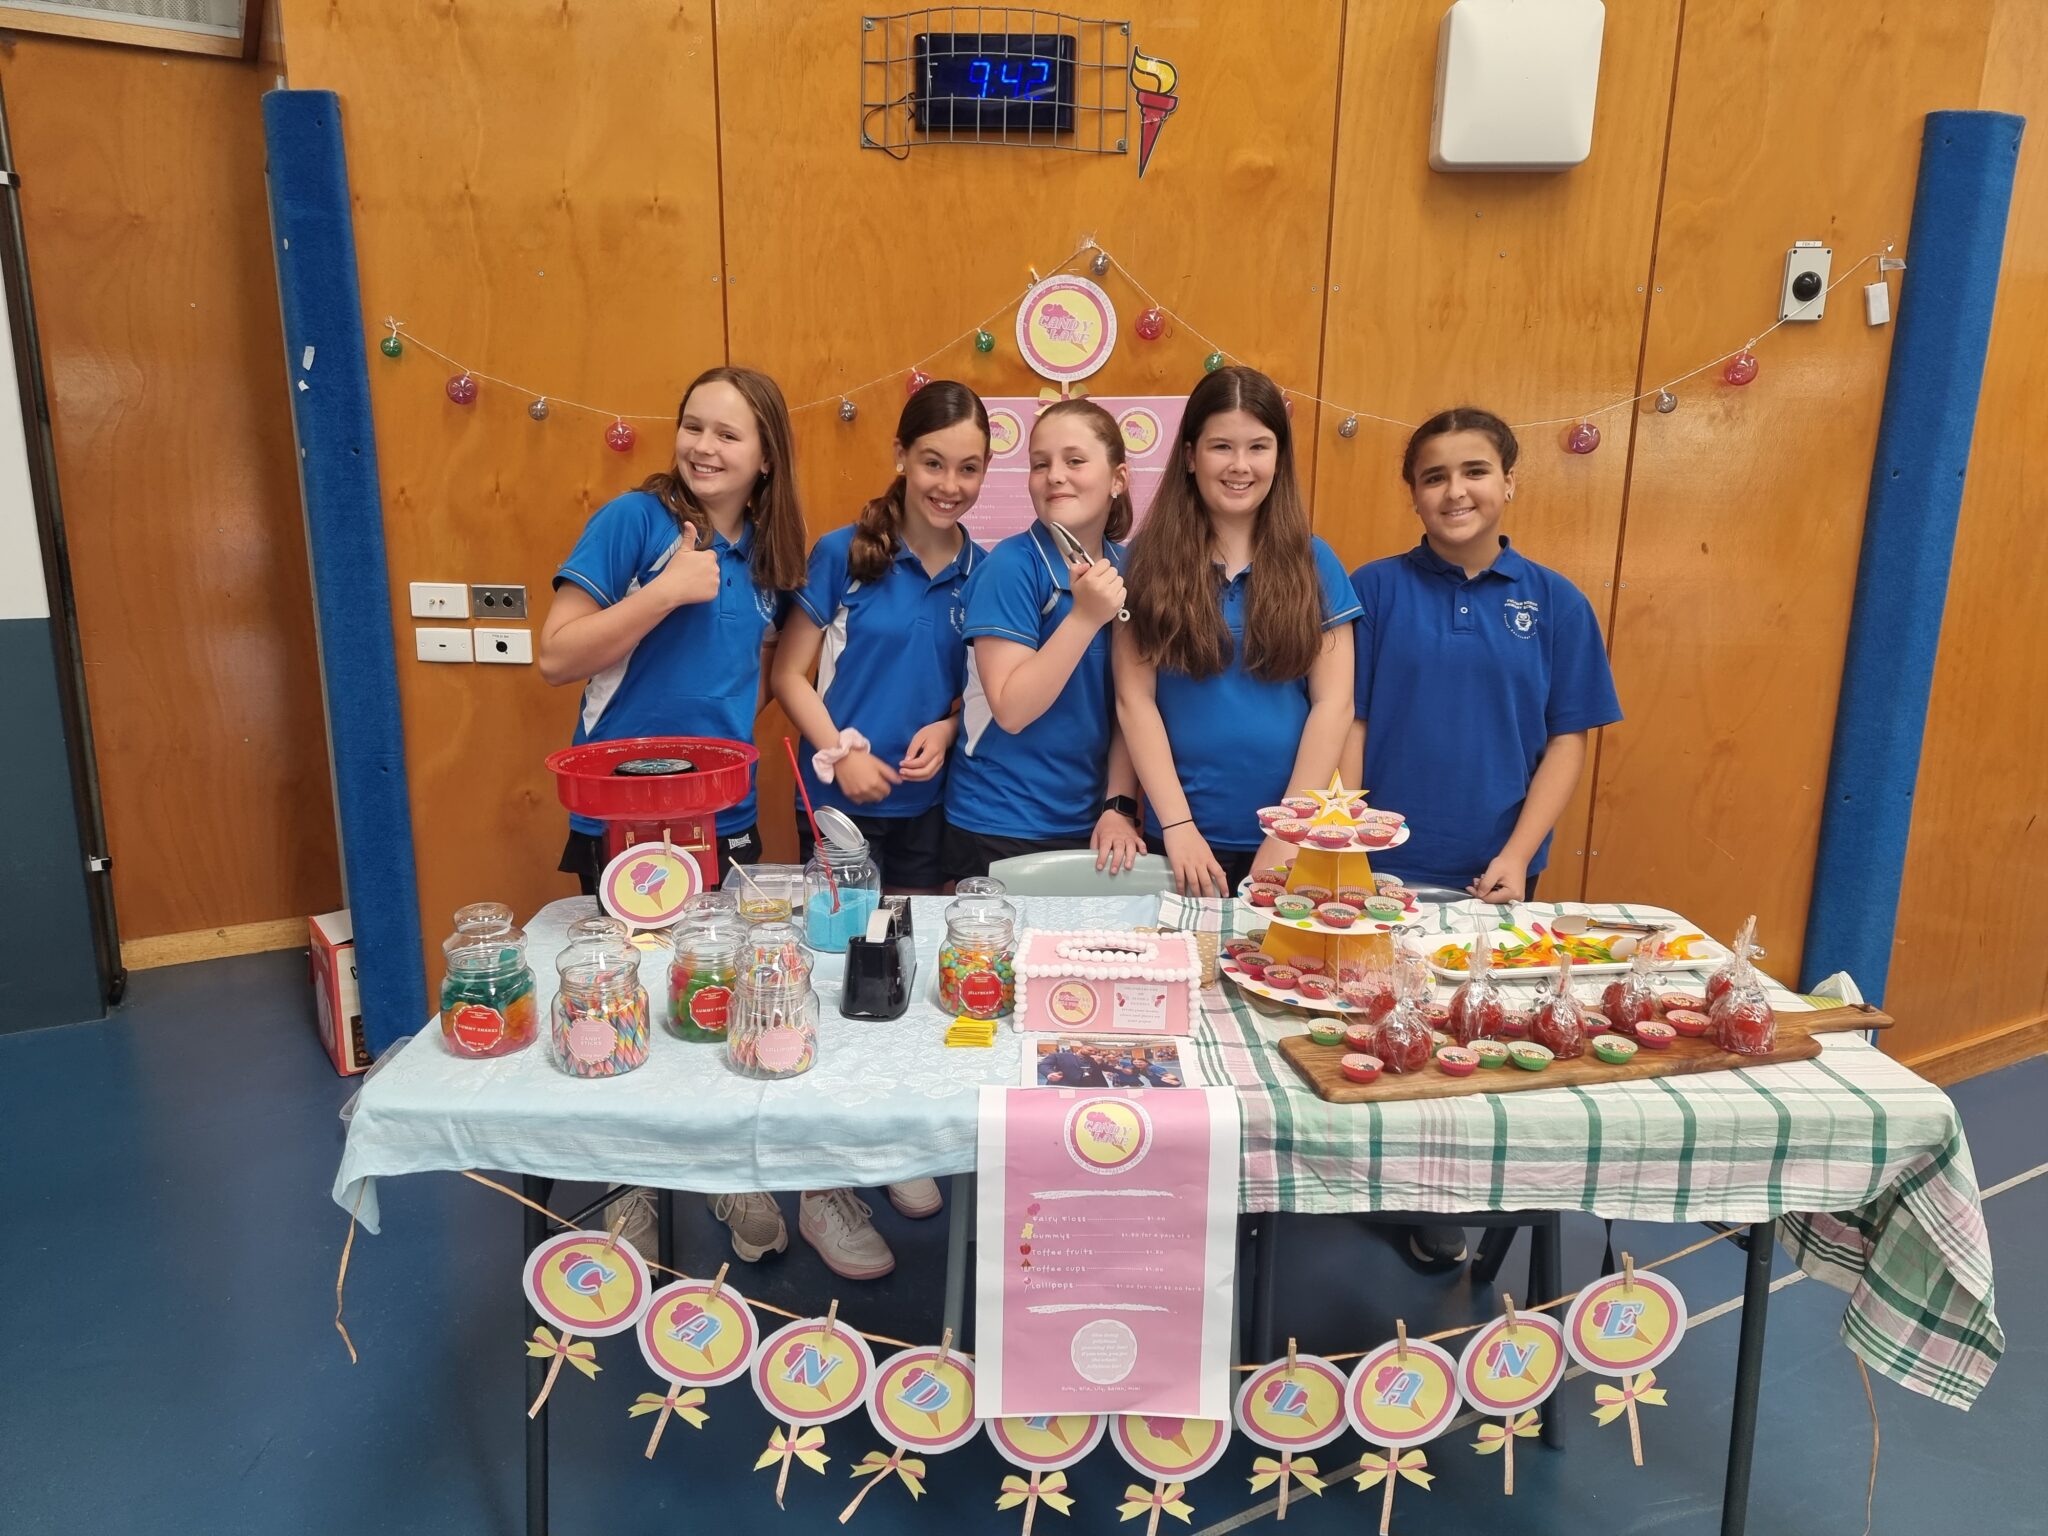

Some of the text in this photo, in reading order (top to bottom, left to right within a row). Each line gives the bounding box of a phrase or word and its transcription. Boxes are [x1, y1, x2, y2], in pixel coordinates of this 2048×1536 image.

[970, 61, 1050, 100] 9:42
[1039, 314, 1093, 333] CANDY
[1047, 328, 1090, 345] LANE
[1084, 1119, 1132, 1138] CANDY
[565, 1259, 617, 1296] C
[782, 1344, 843, 1386] N
[897, 1371, 952, 1412] D
[1266, 1300, 1645, 1416] L A N E
